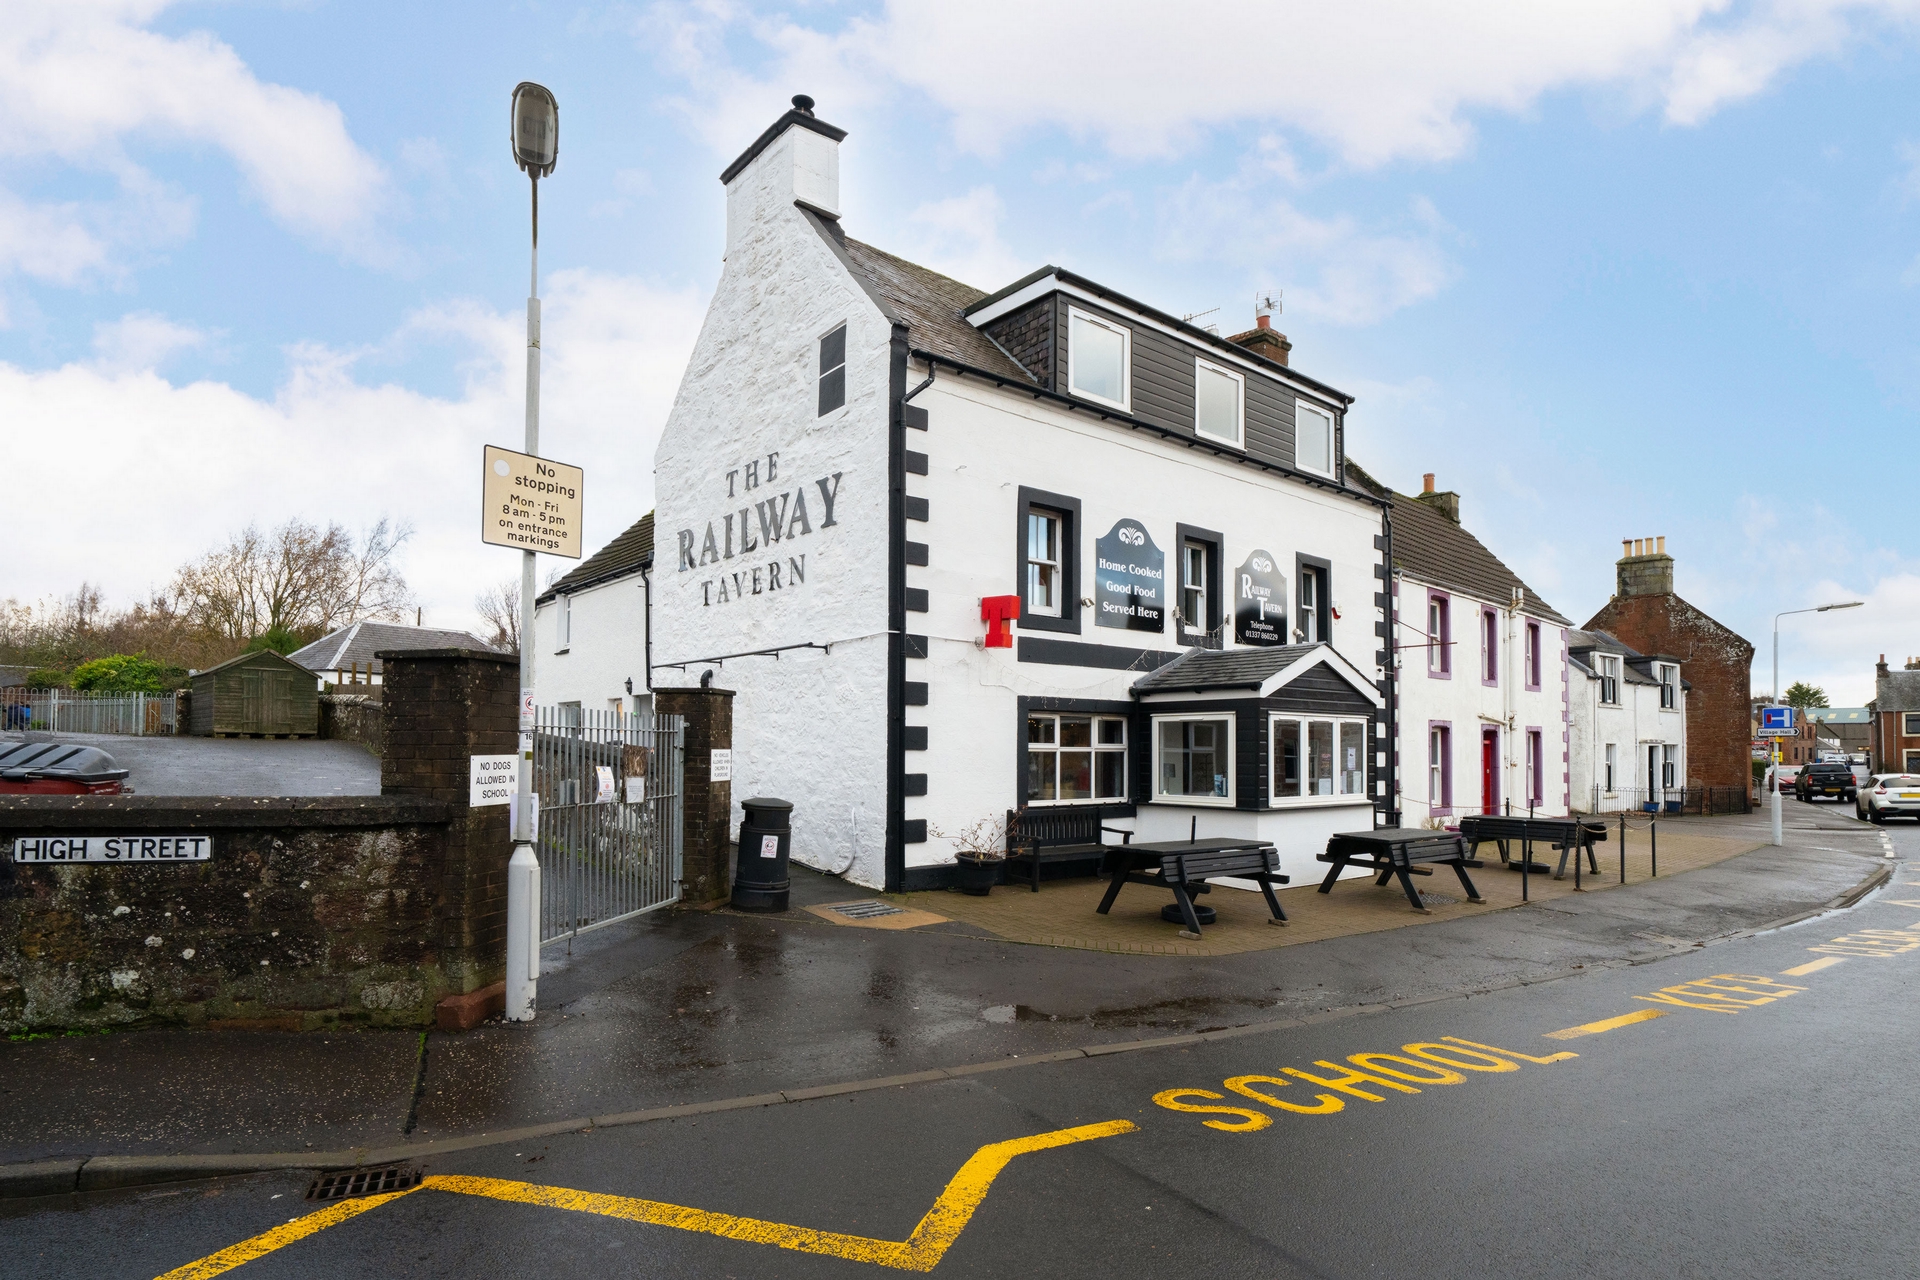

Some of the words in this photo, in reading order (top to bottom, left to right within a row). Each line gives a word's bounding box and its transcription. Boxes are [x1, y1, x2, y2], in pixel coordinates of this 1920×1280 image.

[536, 463, 556, 478] No
[726, 451, 779, 498] THE
[515, 475, 575, 499] stopping
[510, 494, 535, 508] Mon
[544, 501, 559, 513] Fri
[499, 519, 513, 528] on
[518, 522, 568, 538] entrance
[677, 471, 843, 573] RAILWAY
[507, 532, 560, 549] markings
[1099, 557, 1127, 573] Home
[1128, 563, 1162, 579] Cooked
[701, 553, 806, 607] TAVERN
[1106, 580, 1131, 594] Good
[1134, 585, 1156, 598] Food
[1102, 601, 1135, 616] Served
[1137, 606, 1159, 619] Here
[1245, 629, 1260, 639] 01337
[1250, 620, 1274, 631] Telephone
[480, 762, 490, 771] NO
[493, 761, 512, 770] DOGS
[475, 775, 507, 785] ALLOWED
[509, 775, 515, 783] IN
[482, 789, 509, 799] SCHOOL
[21, 839, 88, 860] HIGH
[104, 838, 205, 859] STREET
[1151, 1036, 1581, 1133] SCHOOL
[1631, 973, 1810, 1015] KEEP
